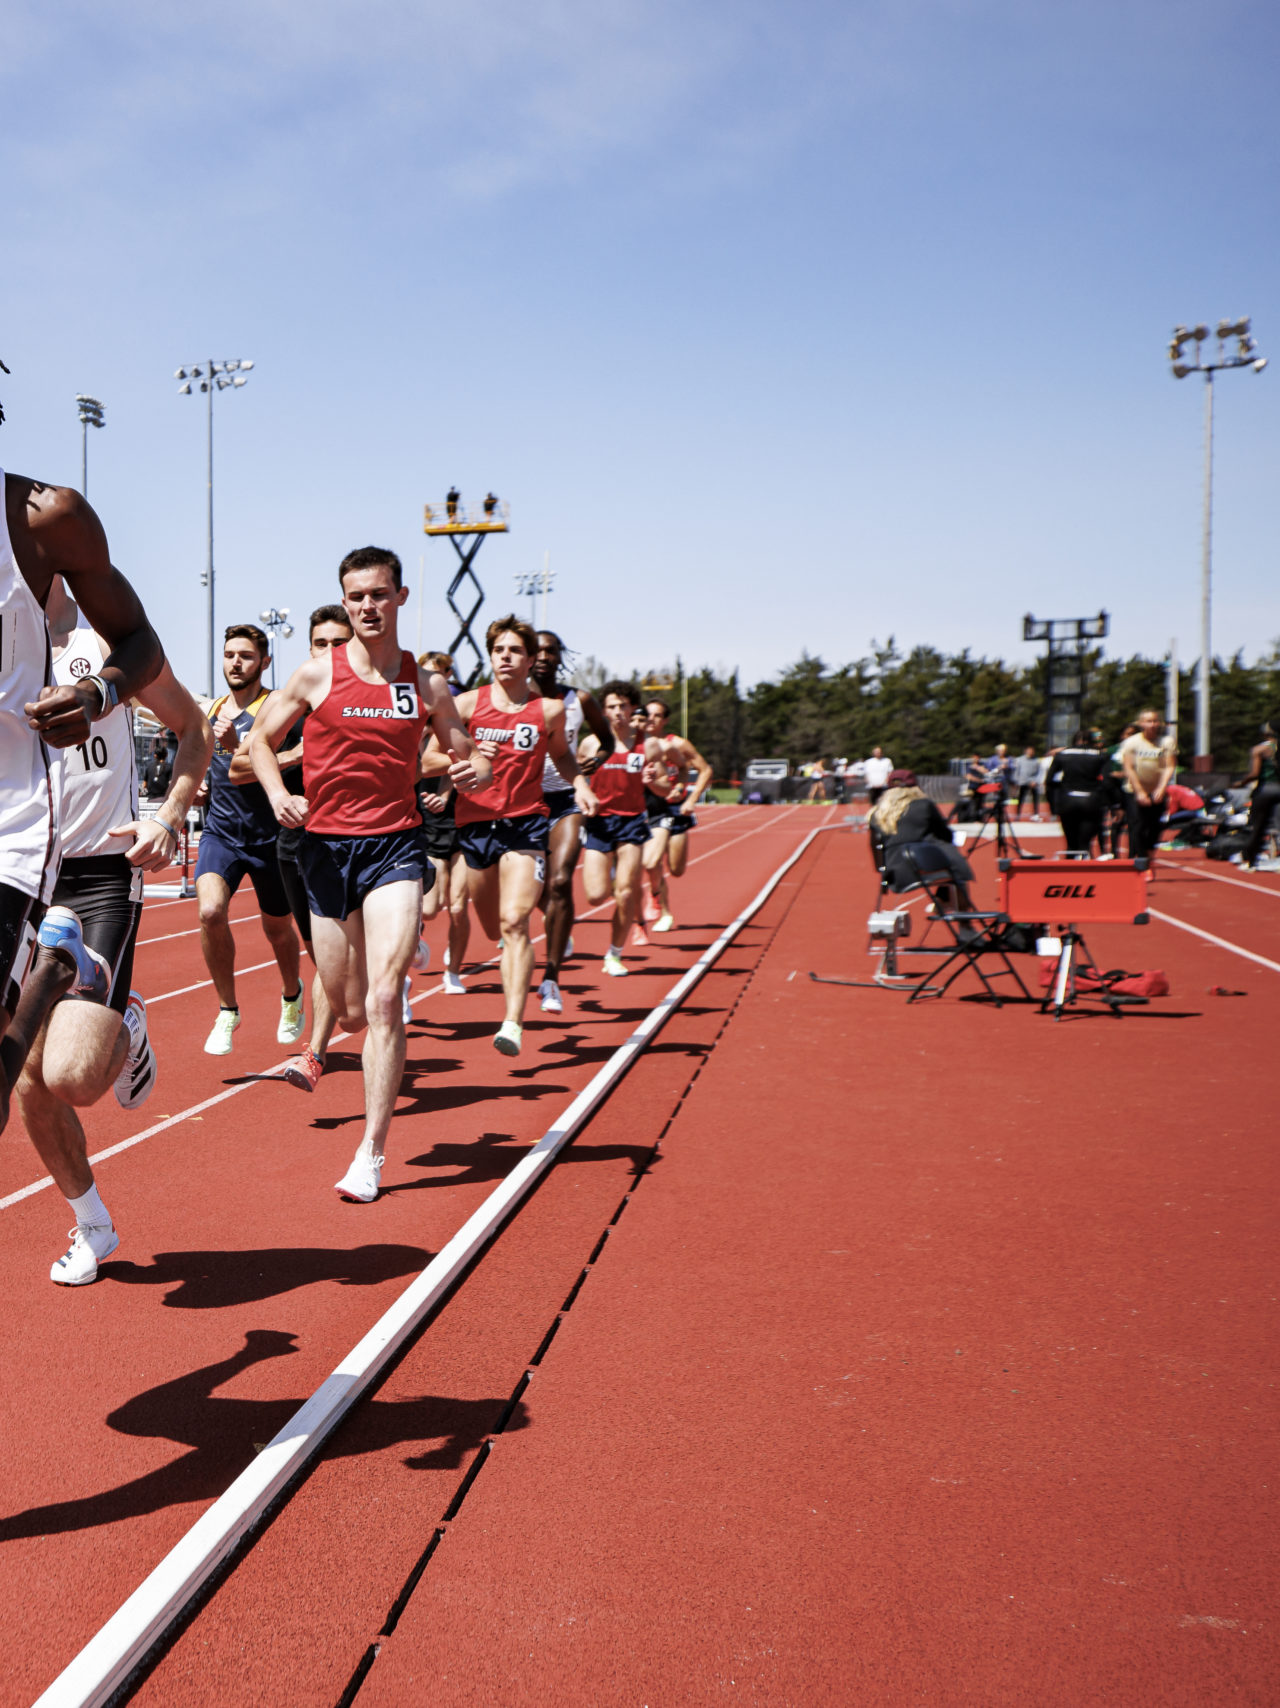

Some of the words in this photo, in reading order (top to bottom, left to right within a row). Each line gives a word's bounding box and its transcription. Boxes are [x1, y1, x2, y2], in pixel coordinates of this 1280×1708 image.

[395, 685, 414, 715] 5
[342, 706, 393, 719] SAMFO
[518, 726, 532, 748] 3
[76, 736, 108, 771] 10
[631, 756, 642, 771] 4
[1044, 885, 1097, 899] GILL
